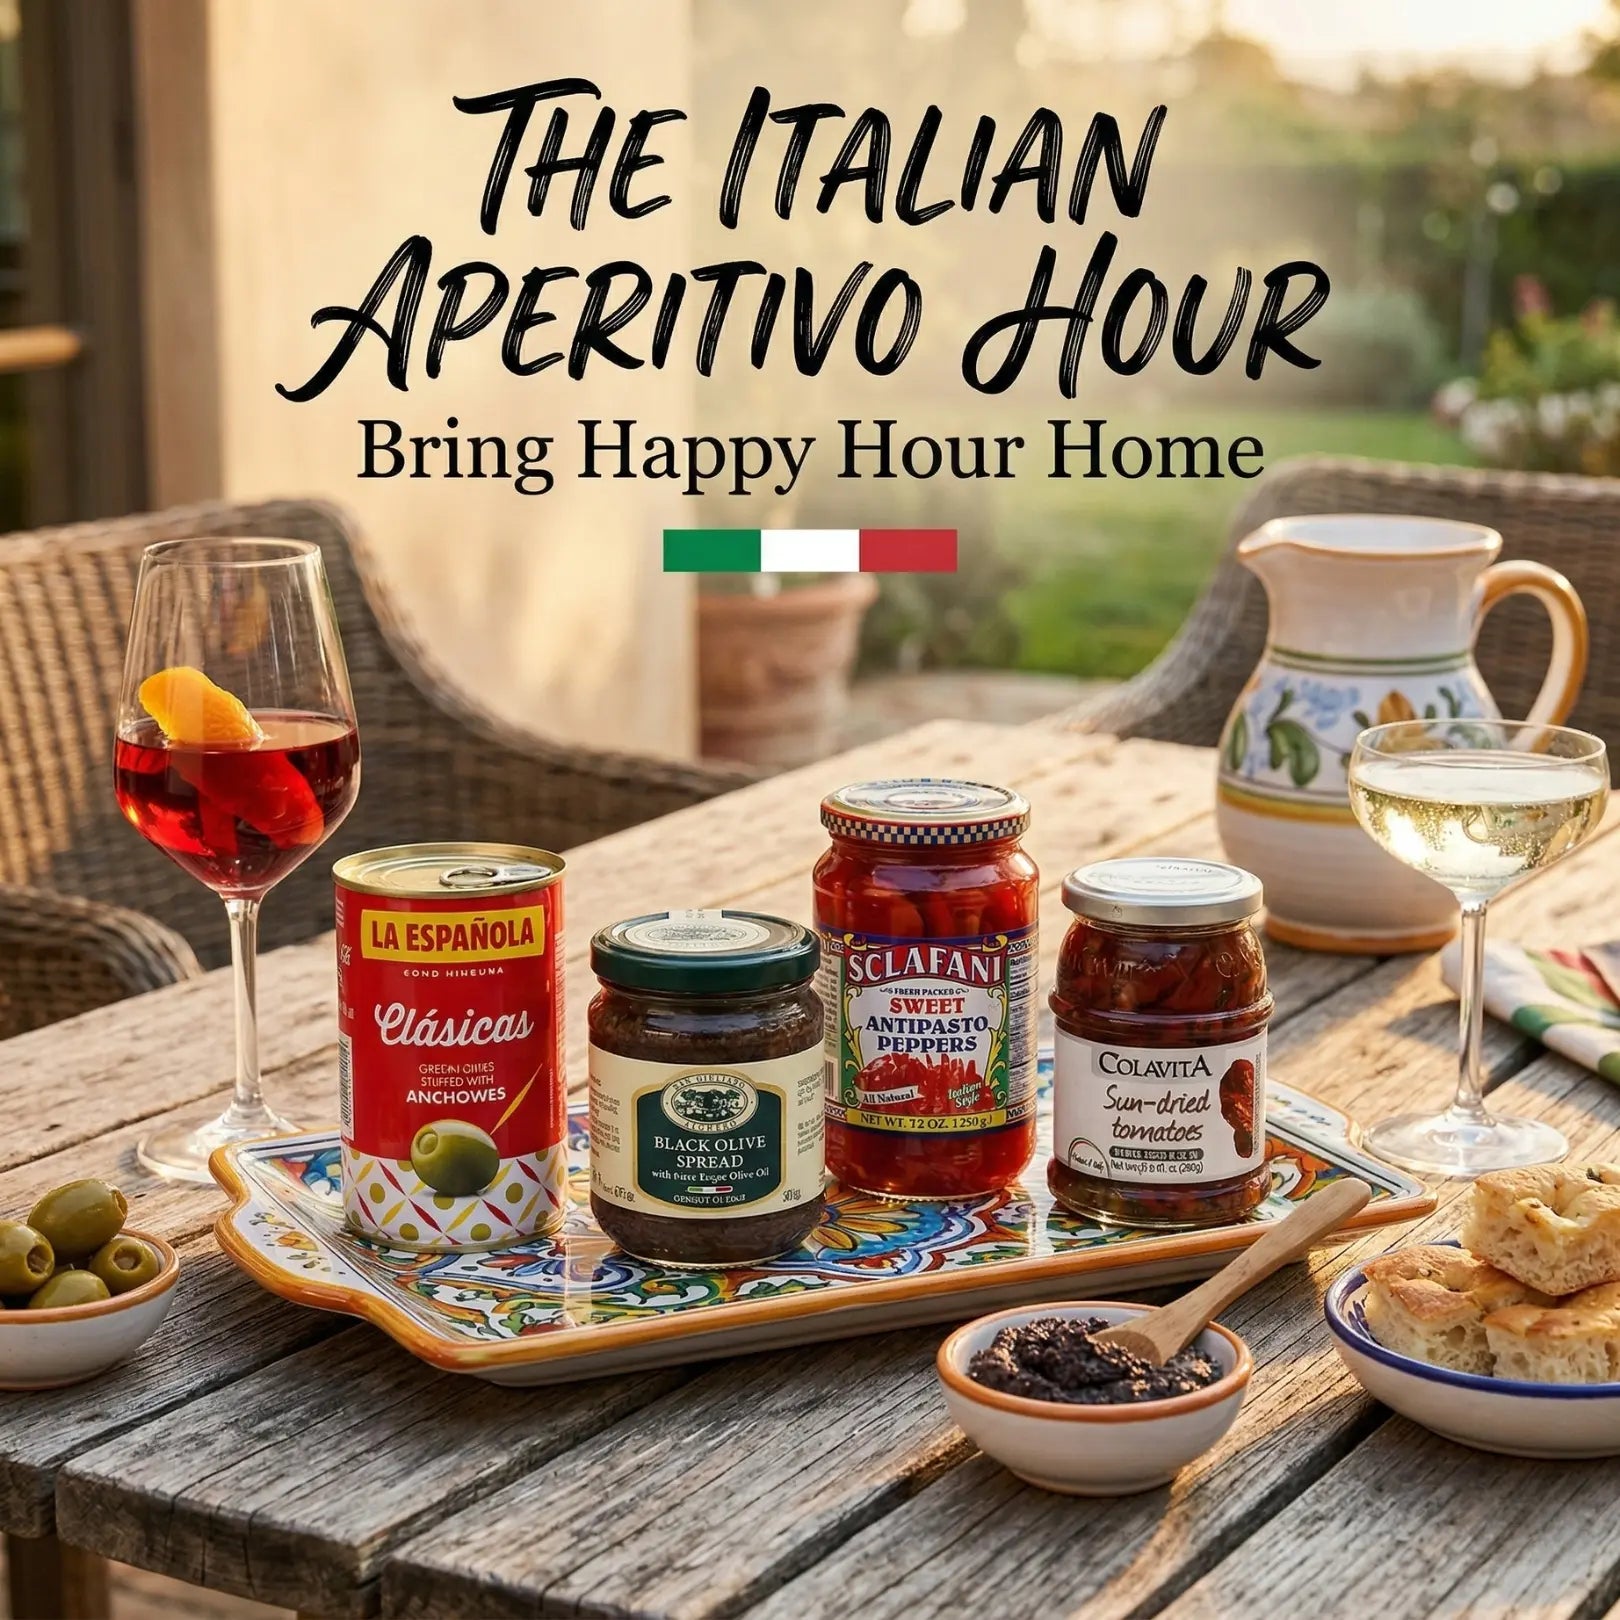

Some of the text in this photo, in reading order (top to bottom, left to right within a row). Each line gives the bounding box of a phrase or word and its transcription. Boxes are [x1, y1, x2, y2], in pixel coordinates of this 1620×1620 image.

[372, 917, 534, 952] LA ESPAÑOLA
[849, 947, 1001, 983] SCLAFANI
[889, 997, 965, 1014] SWEET
[374, 1002, 534, 1047] Clásicas
[866, 1016, 988, 1035] ANTIPASTO
[878, 1036, 977, 1053] PEPPERS
[1099, 1051, 1213, 1078] COLAVITA
[421, 1074, 494, 1087] STUFFED WITH
[863, 1094, 875, 1103] All
[1103, 1084, 1212, 1115] Sun-dried
[861, 1113, 882, 1125] NET
[884, 1116, 906, 1128] WT.
[927, 1118, 948, 1129] OZ.
[1112, 1116, 1204, 1143] tomatoes
[654, 1135, 767, 1152] BLACK OLIVE
[676, 1154, 744, 1169] SPREAD
[652, 1169, 671, 1180] with
[729, 1170, 754, 1181] Olive
[756, 1167, 769, 1178] Oil
